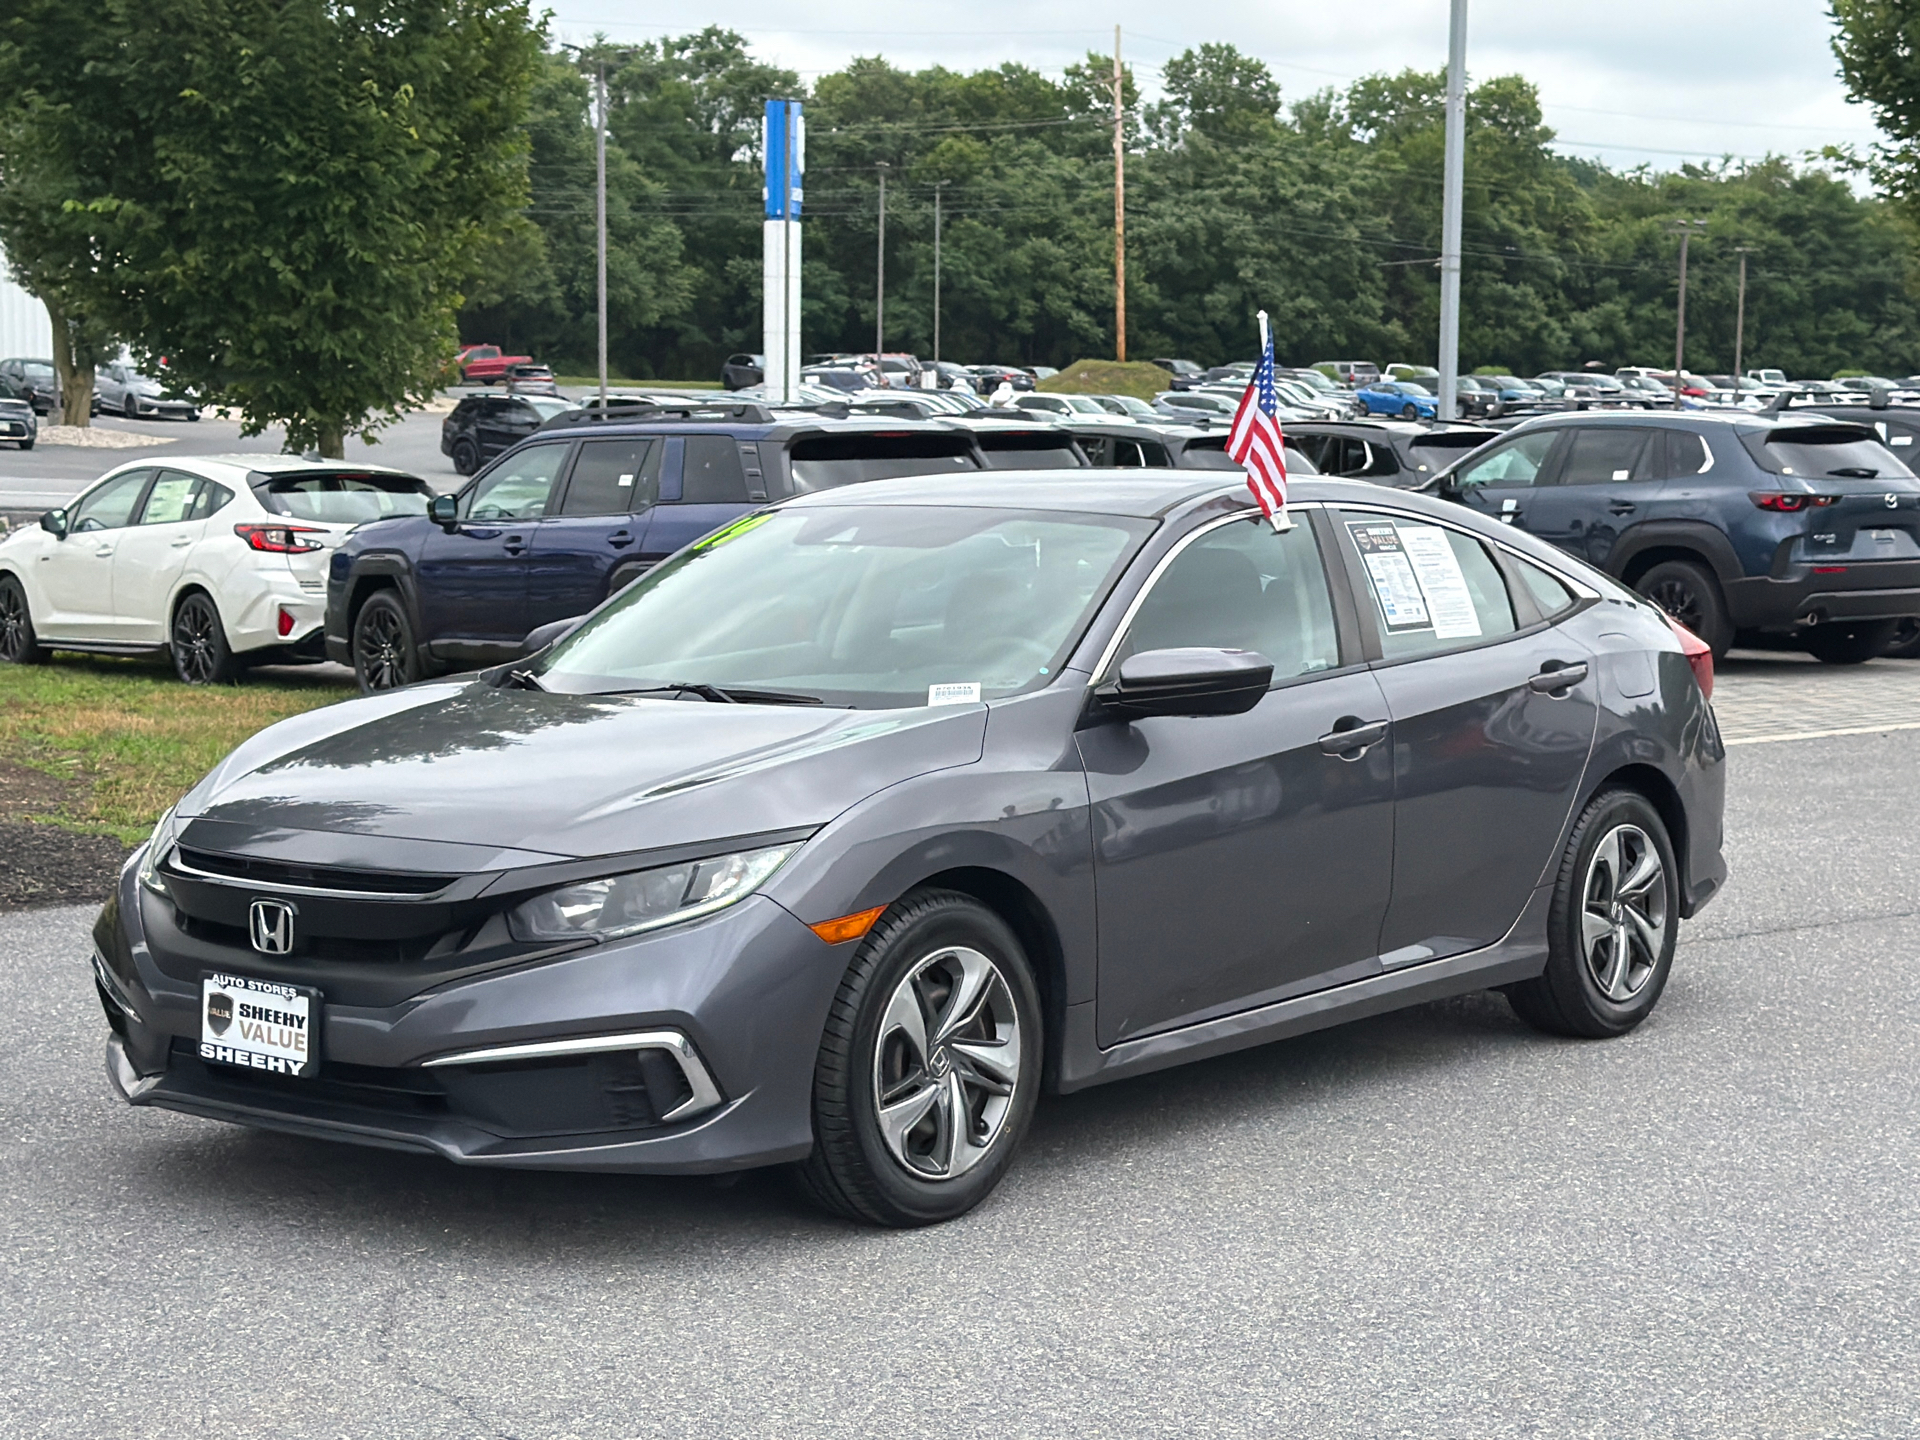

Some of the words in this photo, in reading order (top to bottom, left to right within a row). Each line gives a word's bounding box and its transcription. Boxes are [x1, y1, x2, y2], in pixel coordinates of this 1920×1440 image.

[212, 973, 245, 988] AUTO
[248, 980, 297, 998] STORES
[239, 1003, 306, 1029] SHEEHY
[239, 1020, 306, 1052] VALUE
[200, 1043, 305, 1076] SHEEHY
